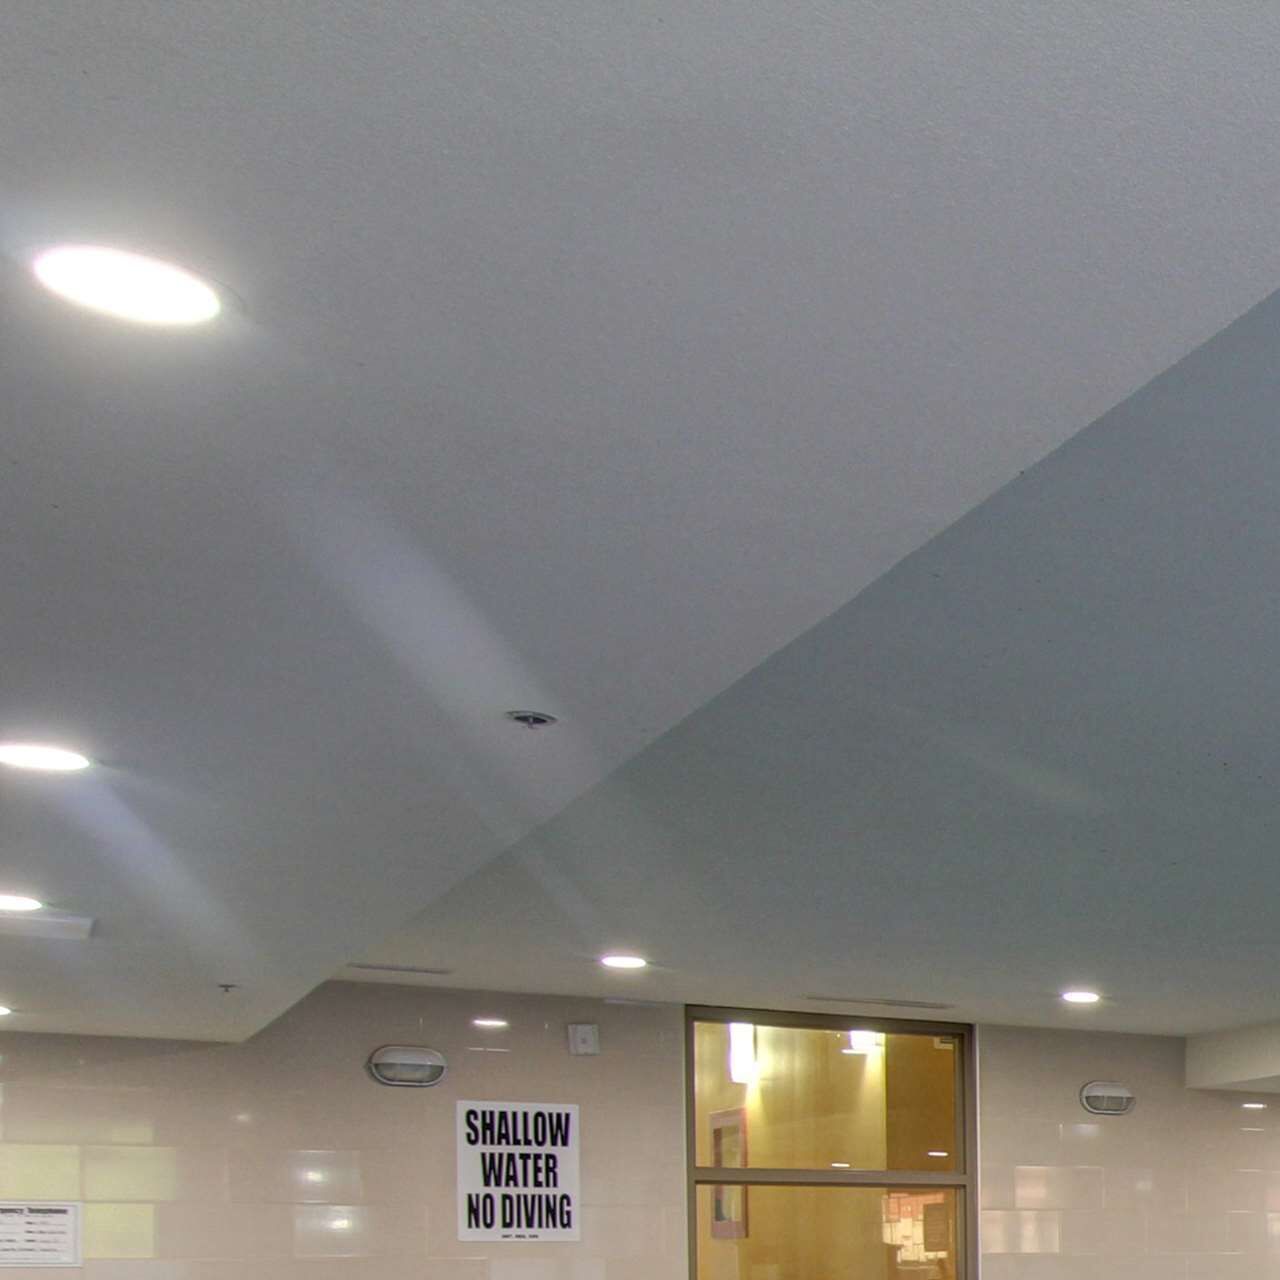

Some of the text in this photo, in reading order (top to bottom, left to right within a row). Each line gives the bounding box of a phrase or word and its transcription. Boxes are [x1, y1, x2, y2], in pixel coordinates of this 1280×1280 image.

[465, 1109, 570, 1147] SHALLOW
[480, 1152, 558, 1188] WATER
[467, 1193, 572, 1229] NO DIVING
